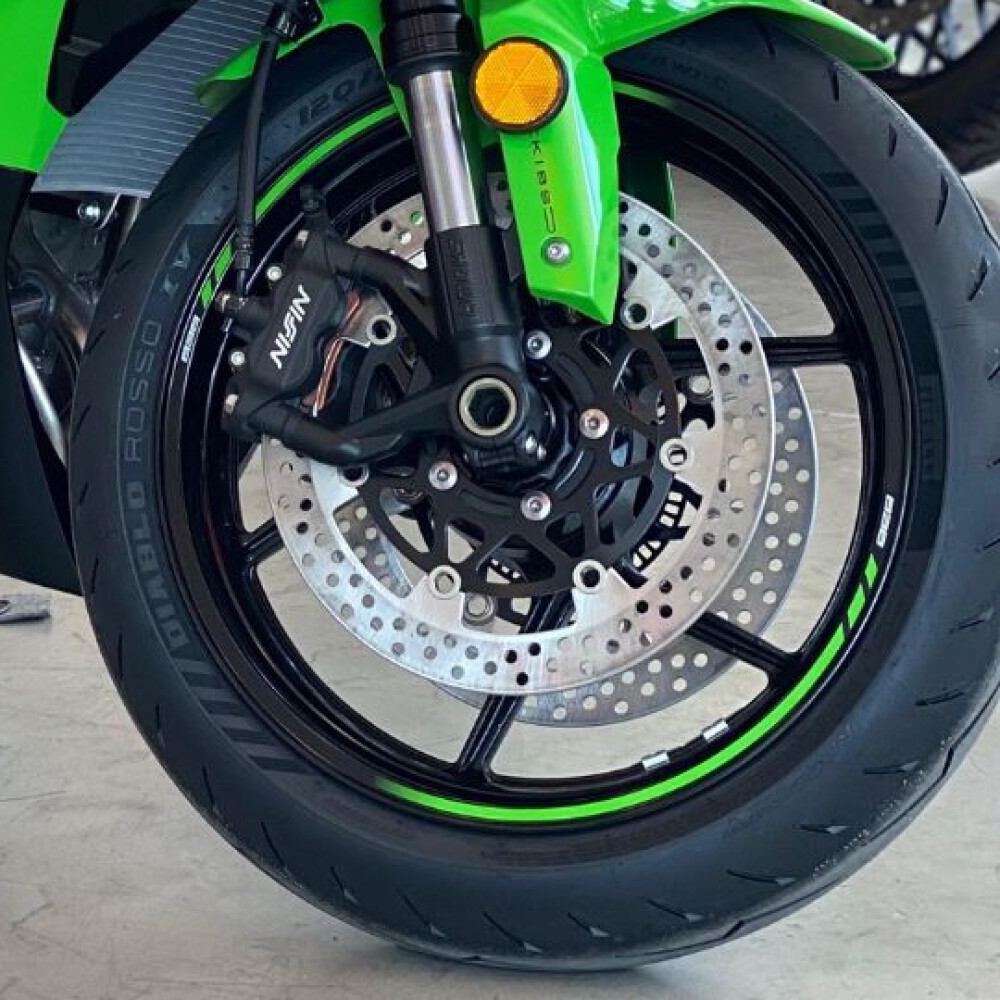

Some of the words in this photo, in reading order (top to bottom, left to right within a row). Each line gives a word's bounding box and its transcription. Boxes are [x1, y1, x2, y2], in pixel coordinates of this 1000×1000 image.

[123, 320, 162, 462] ROSSO
[269, 284, 311, 370] NISSIN
[125, 480, 190, 649] DIABLO
